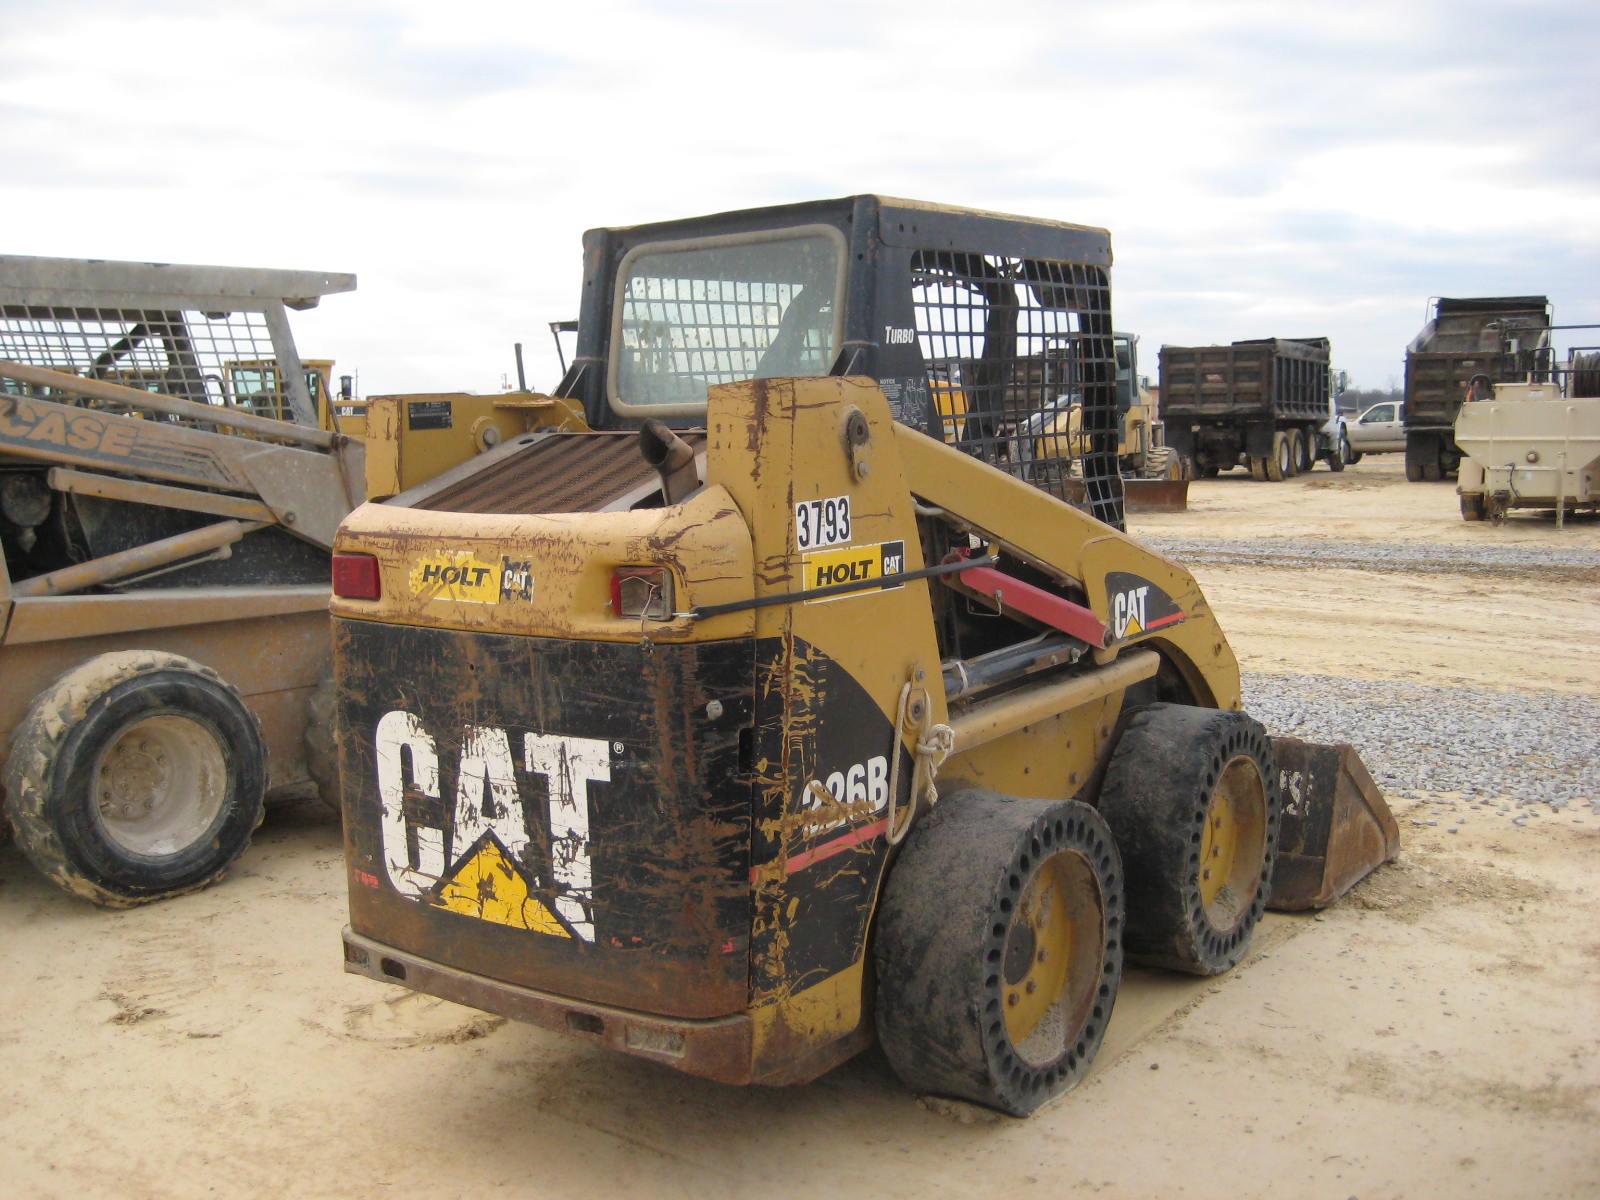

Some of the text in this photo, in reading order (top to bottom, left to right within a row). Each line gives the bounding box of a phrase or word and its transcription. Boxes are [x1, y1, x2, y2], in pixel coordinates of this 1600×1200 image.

[0, 400, 138, 457] CASE
[797, 497, 850, 547] 3793
[422, 564, 527, 590] HOLT CAT
[816, 554, 901, 586] HOLT CAT
[1114, 586, 1148, 639] CAT
[375, 710, 611, 943] CAT
